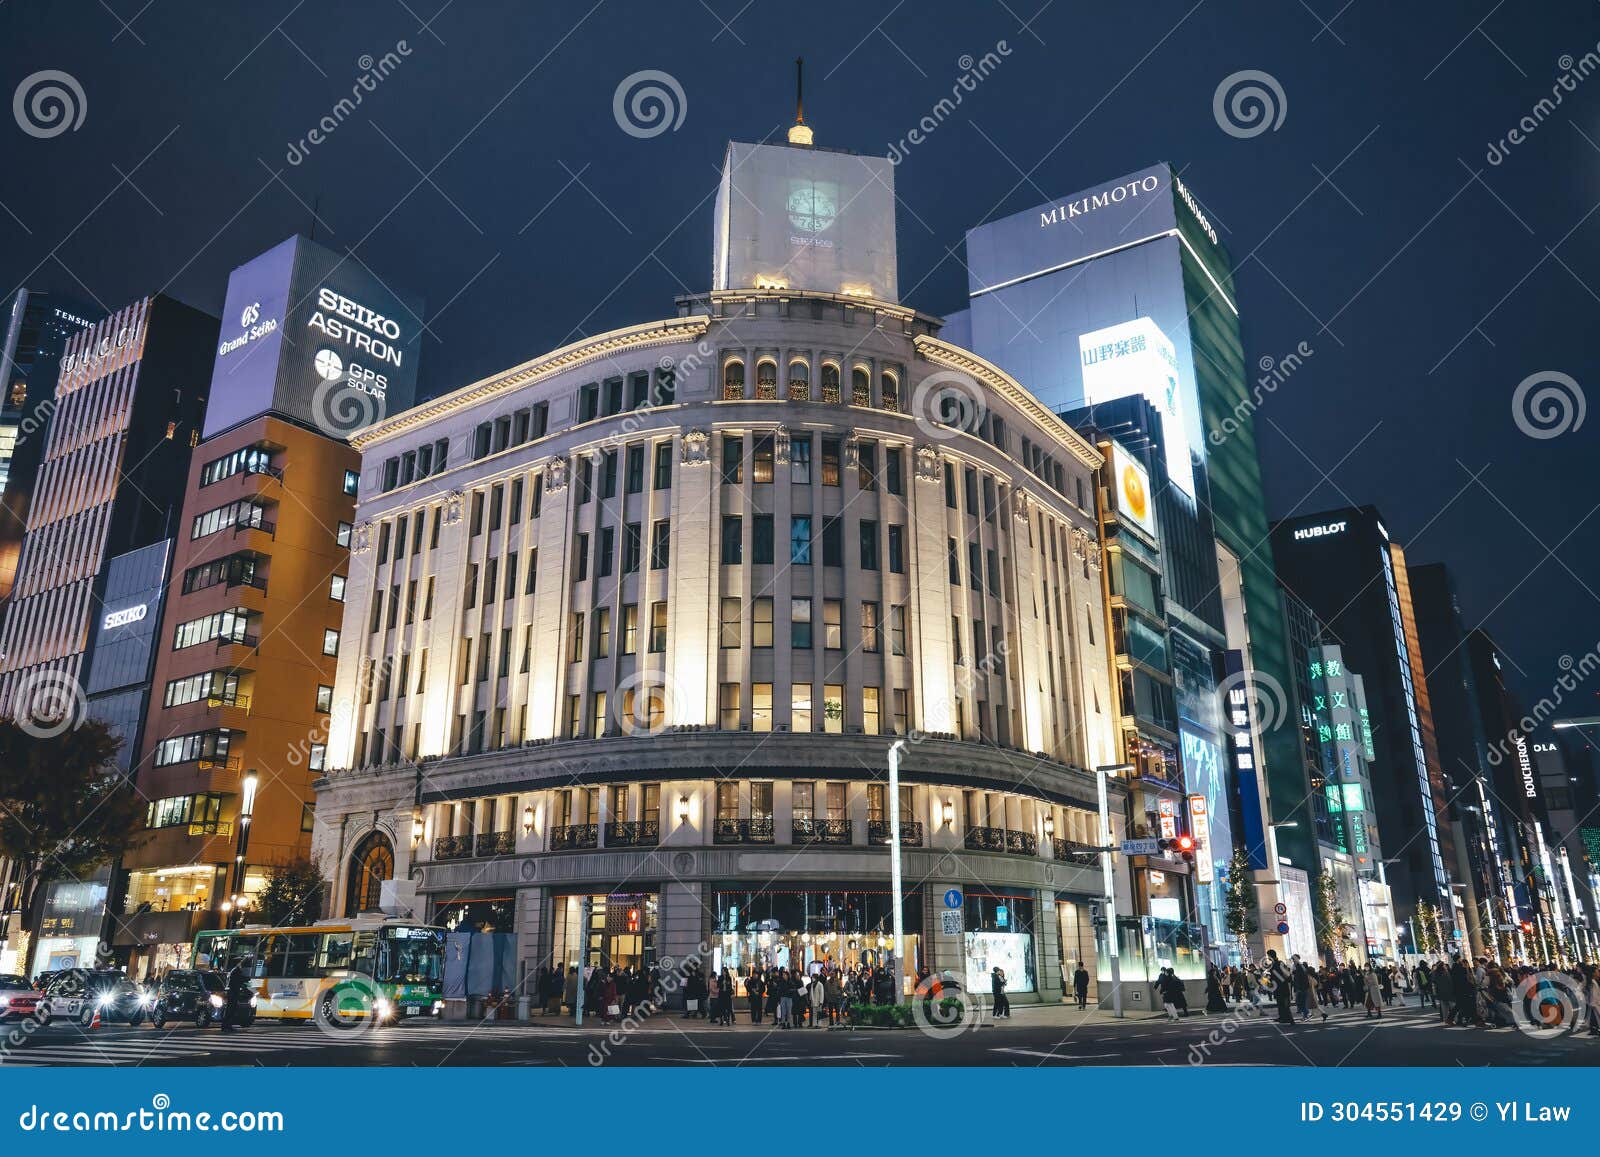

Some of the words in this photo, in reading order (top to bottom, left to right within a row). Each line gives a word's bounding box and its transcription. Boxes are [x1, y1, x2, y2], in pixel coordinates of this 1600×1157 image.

[1040, 175, 1158, 228] MIKIMOTO
[1176, 177, 1218, 246] MIKIMOTO
[318, 288, 400, 340] SEIKO
[219, 331, 250, 357] Grand
[249, 318, 278, 341] Seiko
[307, 311, 402, 368] ASTRON
[1082, 334, 1146, 366] 山野楽器
[347, 378, 386, 402] SOLAR
[349, 363, 388, 391] GPS
[1294, 521, 1347, 540] HUBLOT
[104, 604, 147, 630] SEIKO
[1326, 660, 1351, 741] 教文館
[1515, 736, 1537, 798] BOUCHERON
